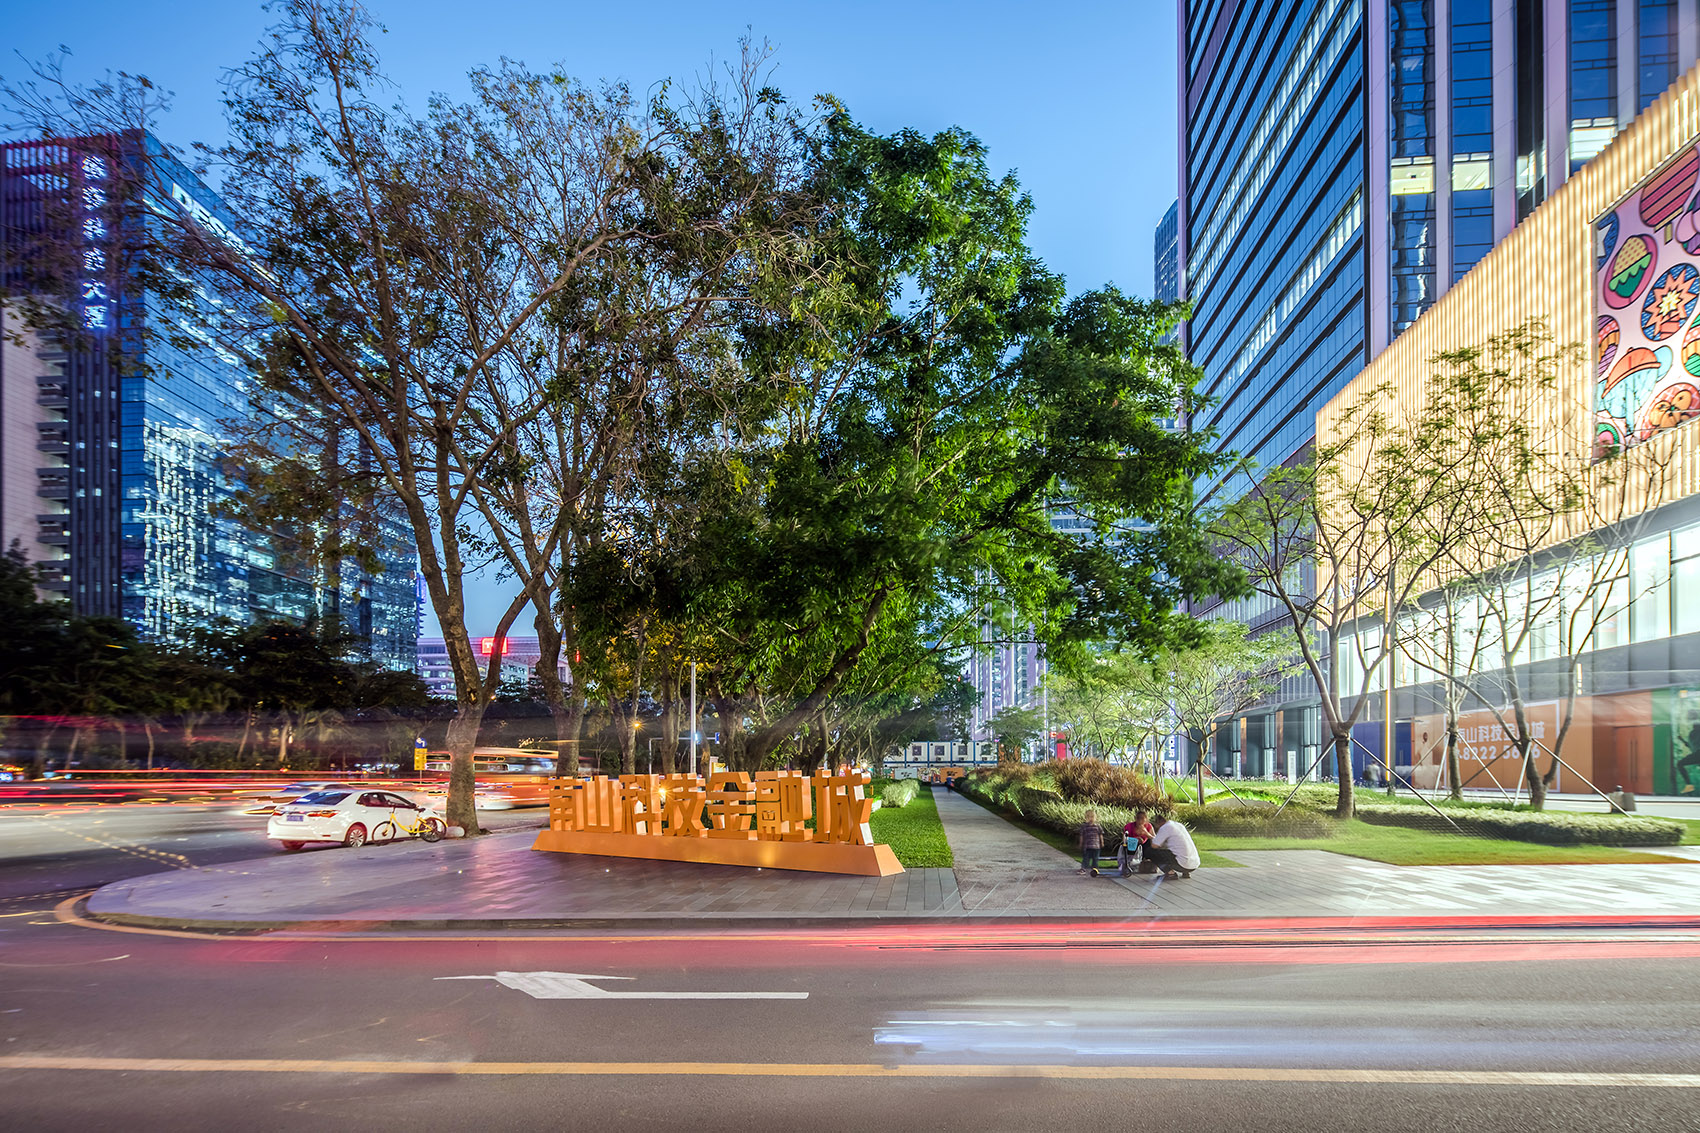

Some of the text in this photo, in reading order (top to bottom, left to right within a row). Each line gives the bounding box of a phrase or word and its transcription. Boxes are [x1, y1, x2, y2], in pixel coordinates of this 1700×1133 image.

[1458, 721, 1545, 743] 南山科技金城
[1503, 743, 1541, 760] 566
[550, 769, 873, 846] 南山科技金融城
